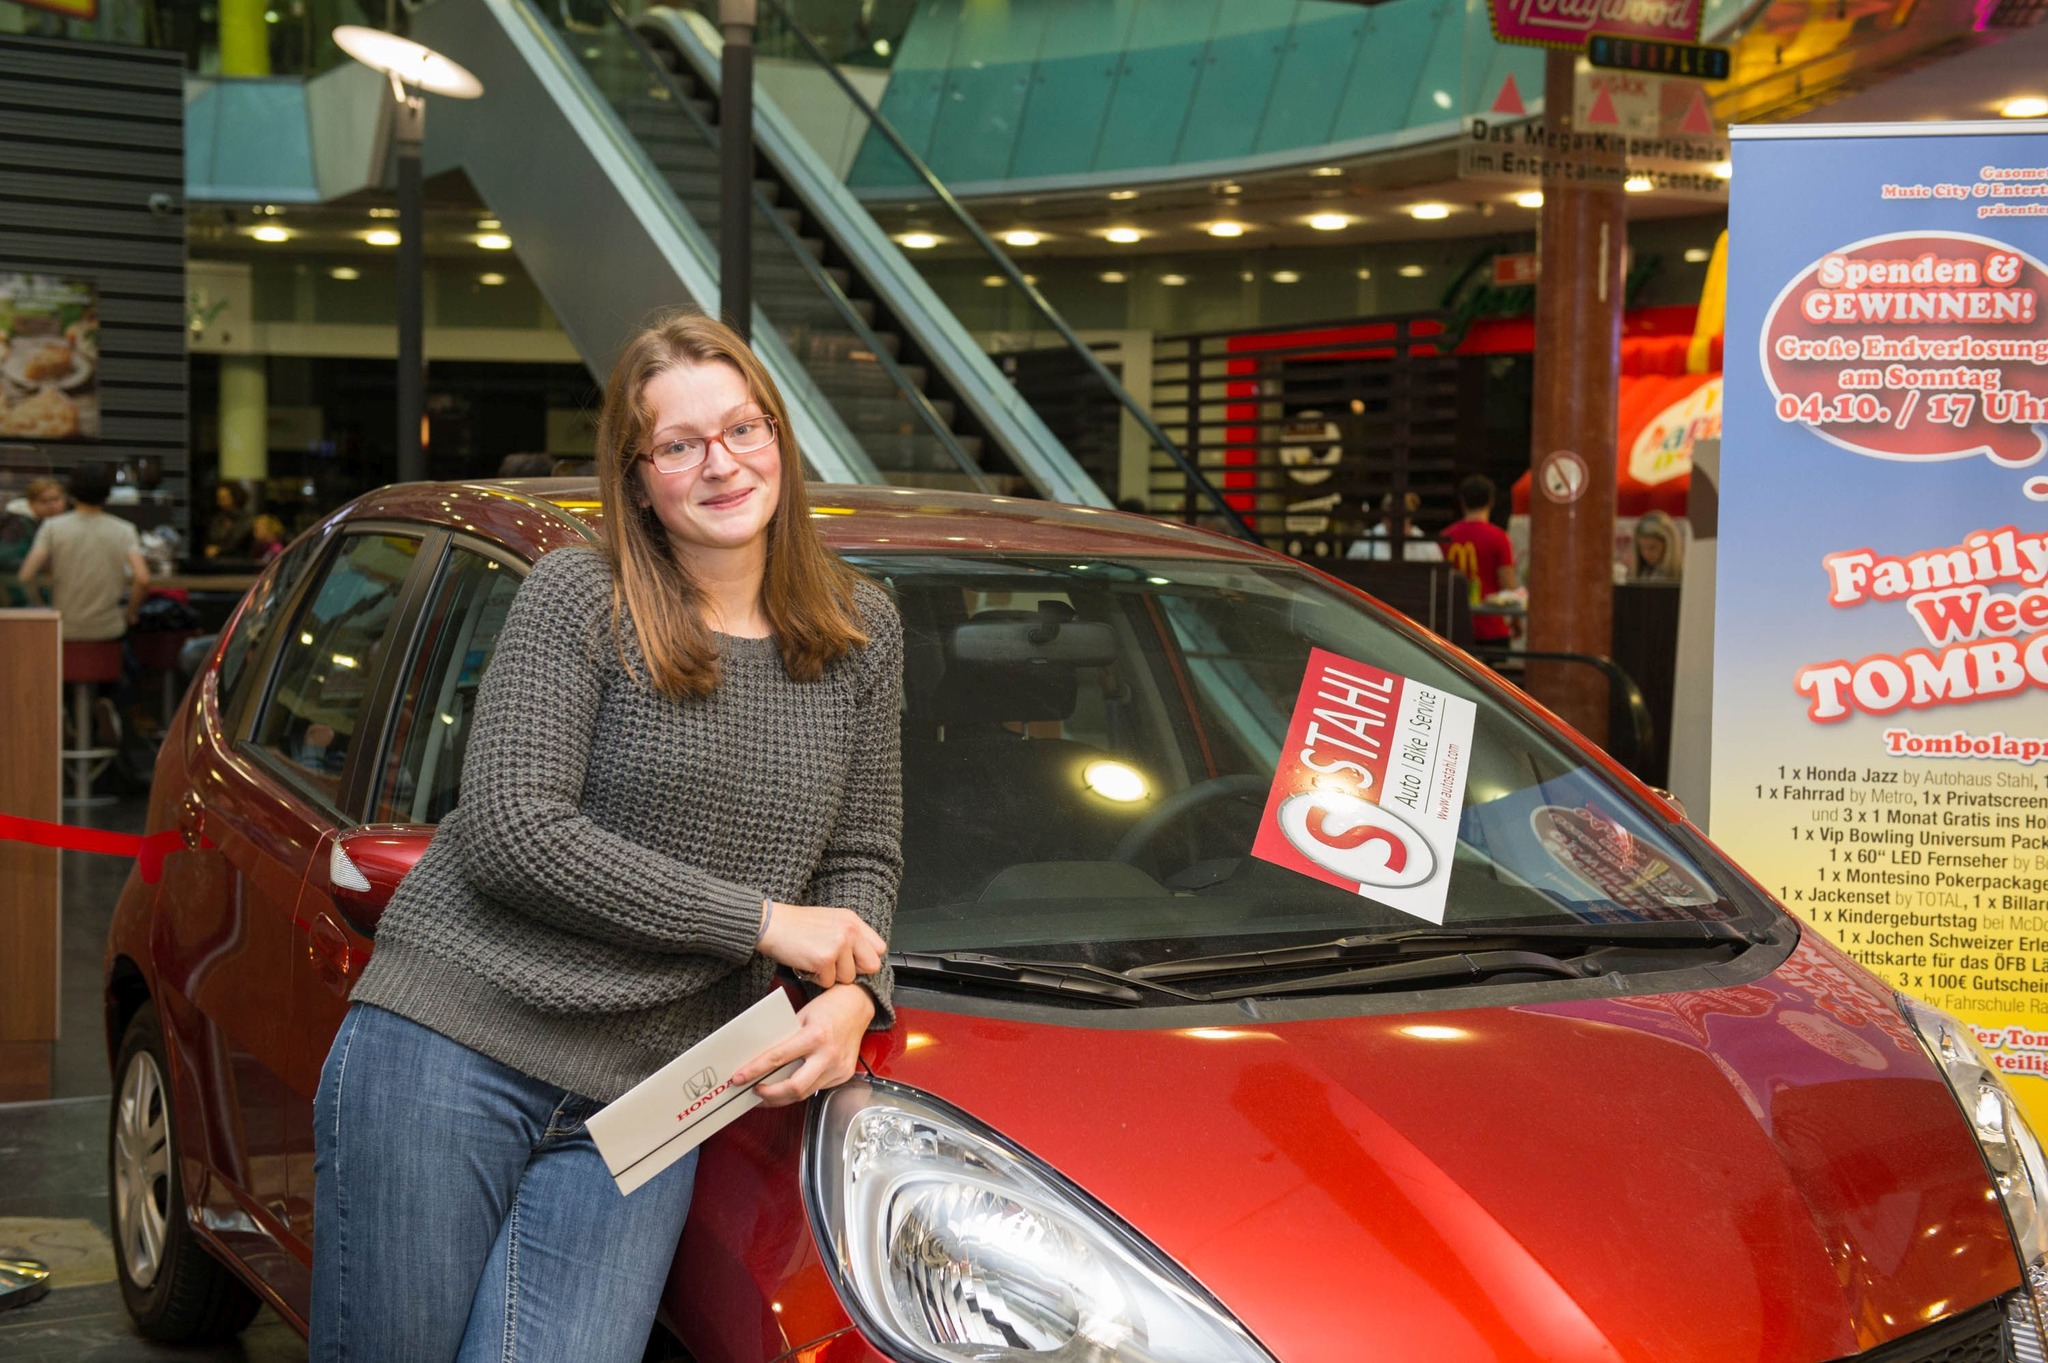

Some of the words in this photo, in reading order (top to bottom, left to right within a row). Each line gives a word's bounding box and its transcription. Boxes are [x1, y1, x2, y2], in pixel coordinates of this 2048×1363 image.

[1472, 119, 1515, 144] Das
[1469, 148, 1494, 170] im
[1883, 186, 1930, 197] Music
[1934, 185, 1969, 199] City
[1973, 184, 1988, 197] &
[1821, 255, 1977, 289] Spenden
[1986, 253, 2019, 283] &
[1805, 291, 2034, 321] GEWINNEN!
[1777, 337, 1858, 360] Große
[1841, 371, 1881, 387] am
[1888, 367, 1998, 390] Sonntag
[1778, 394, 1889, 423] 04.10.
[1928, 396, 1975, 425] 17
[1828, 530, 2048, 603] Family
[1409, 690, 1437, 731] Service
[1299, 666, 1394, 790] STAHL
[1403, 737, 1429, 766] Bike
[1778, 765, 1785, 779] 1
[1792, 768, 1801, 780] x
[1806, 766, 1857, 782] Honda
[1861, 768, 1899, 783] Jazz
[1903, 769, 1920, 787] by
[1924, 770, 1992, 787] Autohaus
[1996, 772, 2038, 791] Stahl,
[1394, 774, 1421, 810] Auto
[1755, 784, 1762, 799] 1
[1769, 788, 1778, 800] x
[1783, 785, 1845, 802] Fahrrad
[1849, 788, 1867, 806] by
[1871, 788, 1918, 807] Metro,
[1923, 790, 1941, 805] 1x
[1946, 791, 2048, 808] Privatscreen
[1811, 807, 1839, 822] und
[1843, 808, 1853, 822] 3
[1858, 811, 1867, 823] x
[1873, 809, 1879, 823] 1
[1887, 809, 1938, 826] Monat
[1943, 811, 1991, 828] Gratis
[1996, 813, 2020, 829] ins
[2025, 814, 2048, 830] Ho
[1791, 826, 1798, 840] 1
[1805, 829, 1814, 841] x
[1819, 827, 1844, 845] Vip
[1849, 828, 1914, 848] Bowling
[1919, 830, 2006, 848] Universum
[1830, 848, 1836, 862] 1
[1843, 852, 1852, 863] x
[1891, 850, 1922, 865] LED
[1927, 851, 2009, 869] Fernseher
[2012, 854, 2031, 873] by
[1818, 867, 1825, 881] 1
[1832, 870, 1841, 882] x
[1846, 868, 1930, 886] Montesino
[1935, 871, 2048, 894] Pokerpackage
[1780, 886, 1787, 900] 1
[1794, 889, 1803, 901] x
[1808, 887, 1891, 905] Jackenset
[1895, 890, 1913, 909] by
[1916, 891, 1968, 911] TOTAL,
[1973, 894, 1980, 909] 1
[1988, 897, 1997, 909] x
[1810, 907, 1816, 921] 1
[1824, 911, 1833, 922] x
[1837, 908, 1977, 932] Kindergeburtstag
[1982, 914, 2005, 930] bei
[1838, 929, 1844, 943] 1
[1852, 932, 1861, 944] x
[1865, 930, 1924, 947] Jochen
[1929, 932, 2014, 951] Schweizer
[1932, 952, 1955, 968] für
[1960, 954, 1989, 970] das
[1994, 952, 2026, 972] ÖFB
[1899, 972, 1909, 987] 3
[1914, 975, 1923, 988] x
[1928, 973, 1967, 990] 100€
[1945, 994, 2025, 1013] Fahrschule
[1969, 1028, 2001, 1044] er
